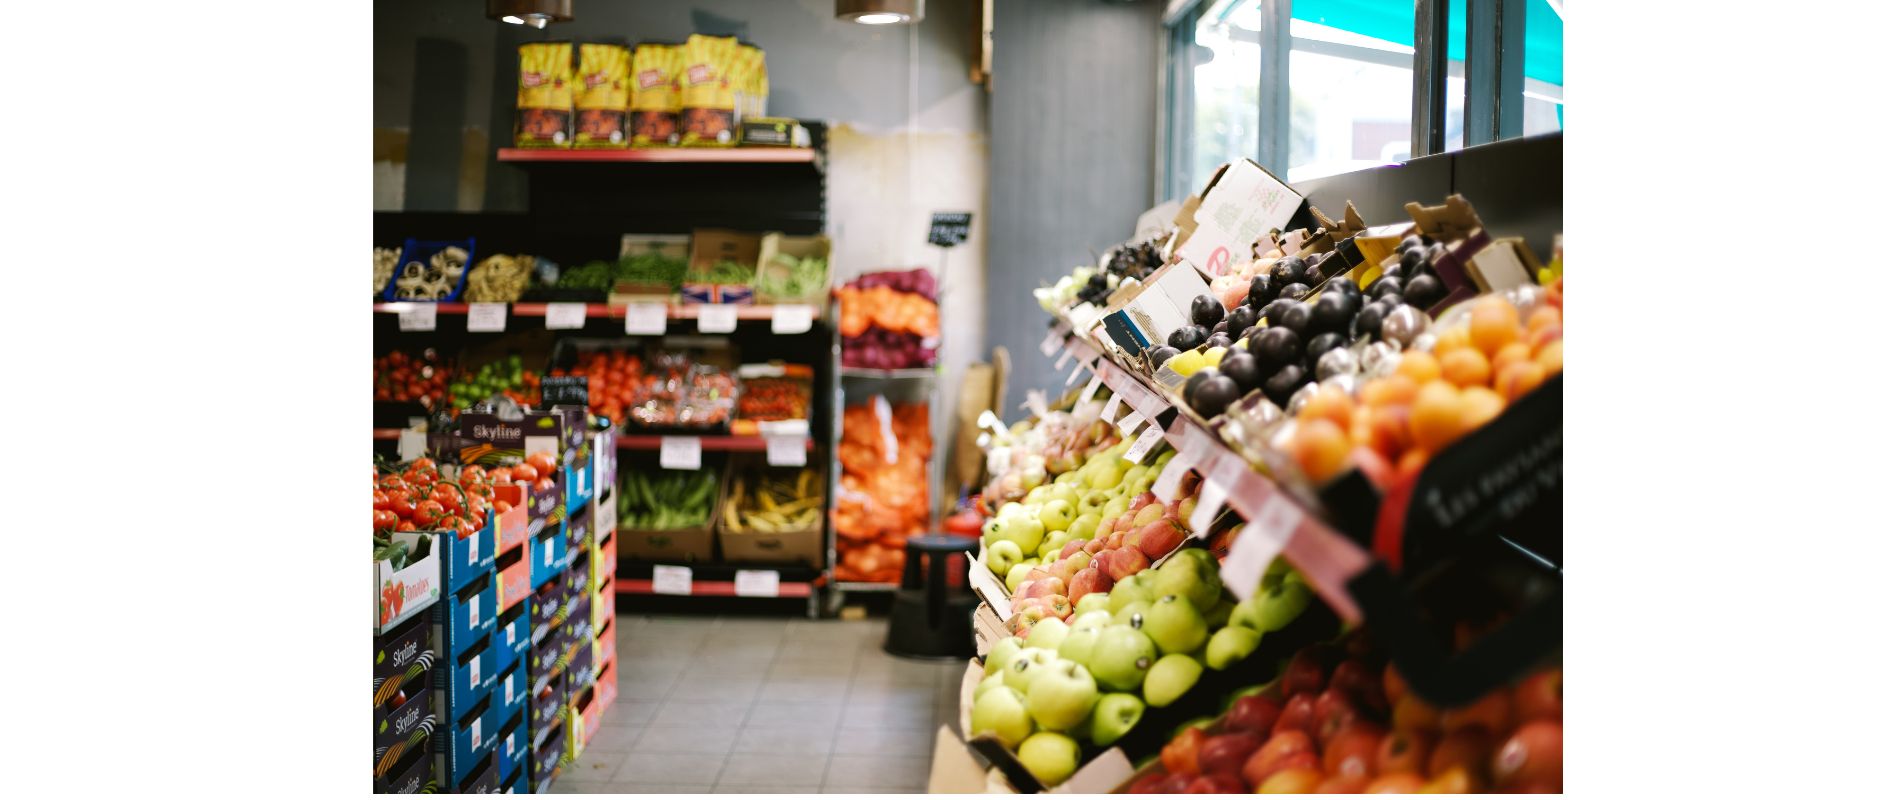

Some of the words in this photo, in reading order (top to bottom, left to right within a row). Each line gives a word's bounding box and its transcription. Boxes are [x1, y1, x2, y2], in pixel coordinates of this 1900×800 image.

[473, 423, 521, 441] Skyline
[393, 641, 417, 668] Skyline
[395, 707, 420, 735] Skyline
[397, 776, 420, 794] line
